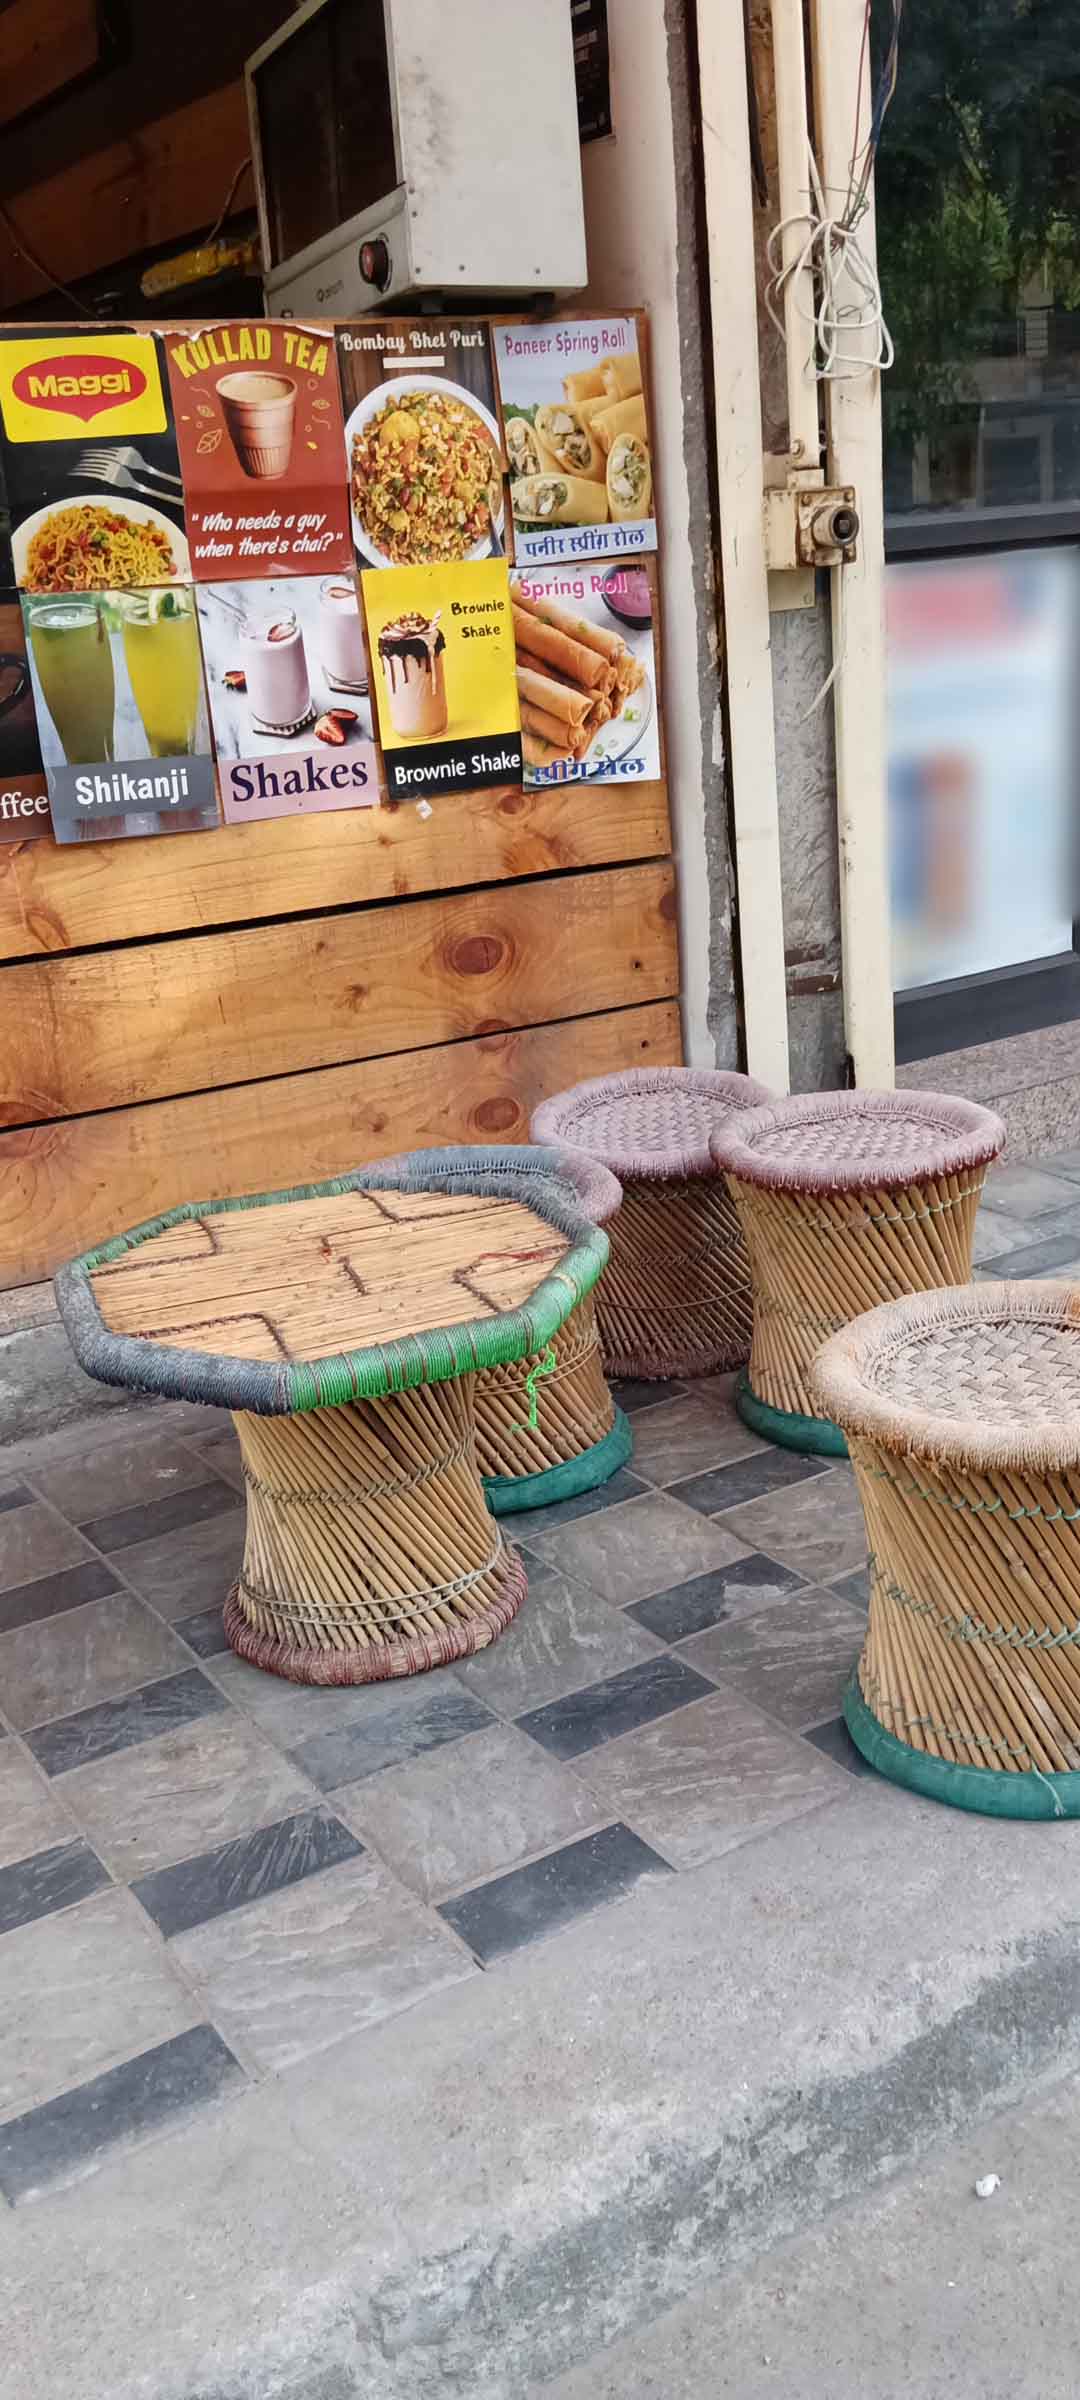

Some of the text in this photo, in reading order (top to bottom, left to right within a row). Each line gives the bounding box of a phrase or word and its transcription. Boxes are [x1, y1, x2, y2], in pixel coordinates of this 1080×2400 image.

[170, 327, 329, 379] KULLAD TEA
[340, 329, 485, 353] Bombay Bhel Puri
[505, 330, 626, 358] Paneer Spring Roll
[28, 369, 132, 399] Maggi
[235, 509, 281, 530] needs
[284, 514, 296, 528] a
[297, 514, 327, 533] guy
[195, 537, 234, 558] when
[525, 535, 566, 557] पनीर
[613, 527, 645, 546] रोल
[519, 571, 629, 602] Spring Roll
[451, 600, 505, 616] Brownie
[461, 624, 501, 639] Shake
[230, 756, 369, 802] Shakes
[394, 751, 521, 786] Brownie Shake
[75, 768, 189, 805] Shikanji
